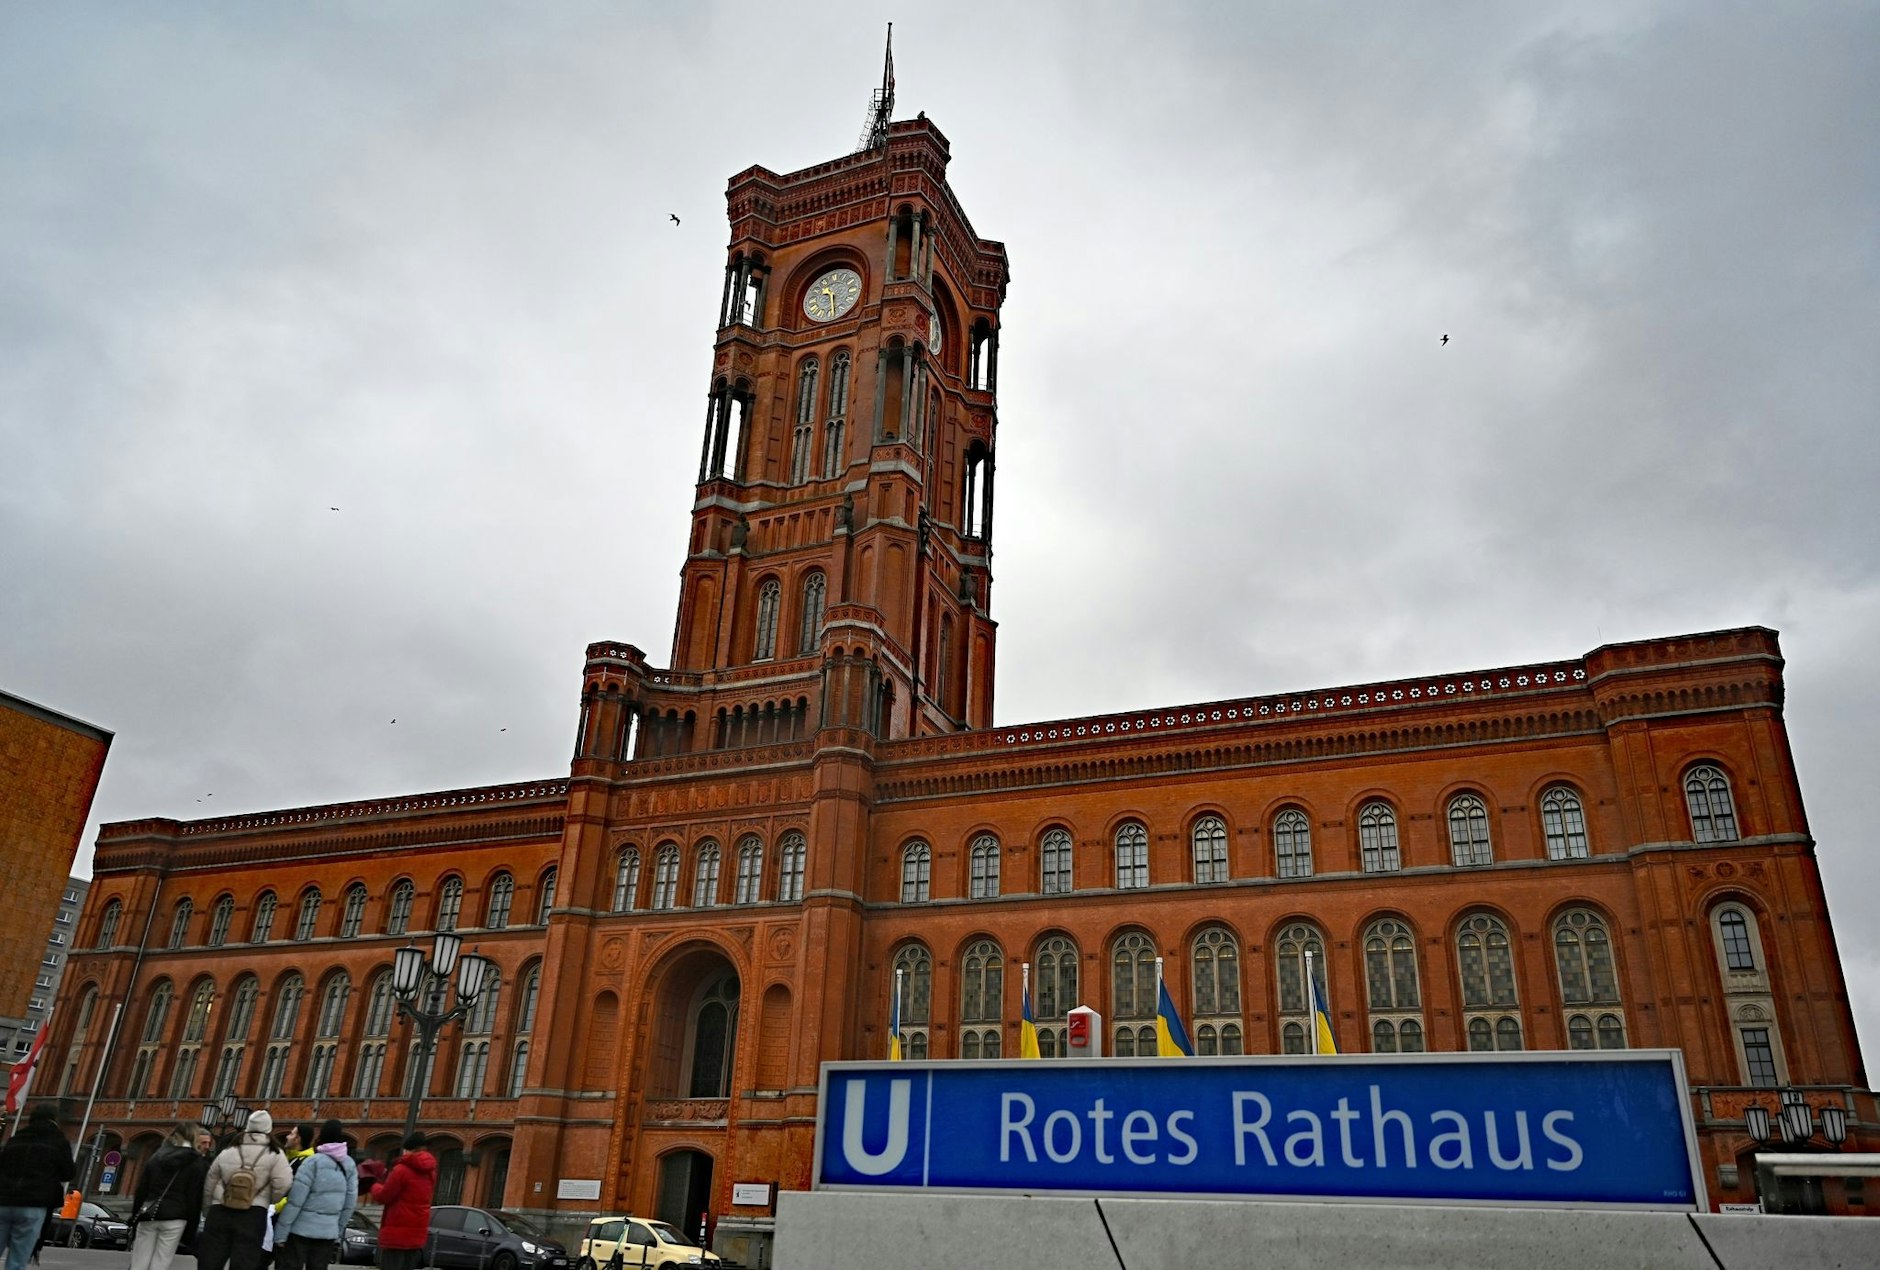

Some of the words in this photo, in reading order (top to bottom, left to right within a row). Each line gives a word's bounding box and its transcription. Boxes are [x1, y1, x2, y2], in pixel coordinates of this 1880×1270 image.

[843, 1080, 910, 1175] U
[1000, 1093, 1198, 1165] Rotes
[1232, 1086, 1583, 1170] Rathaus
